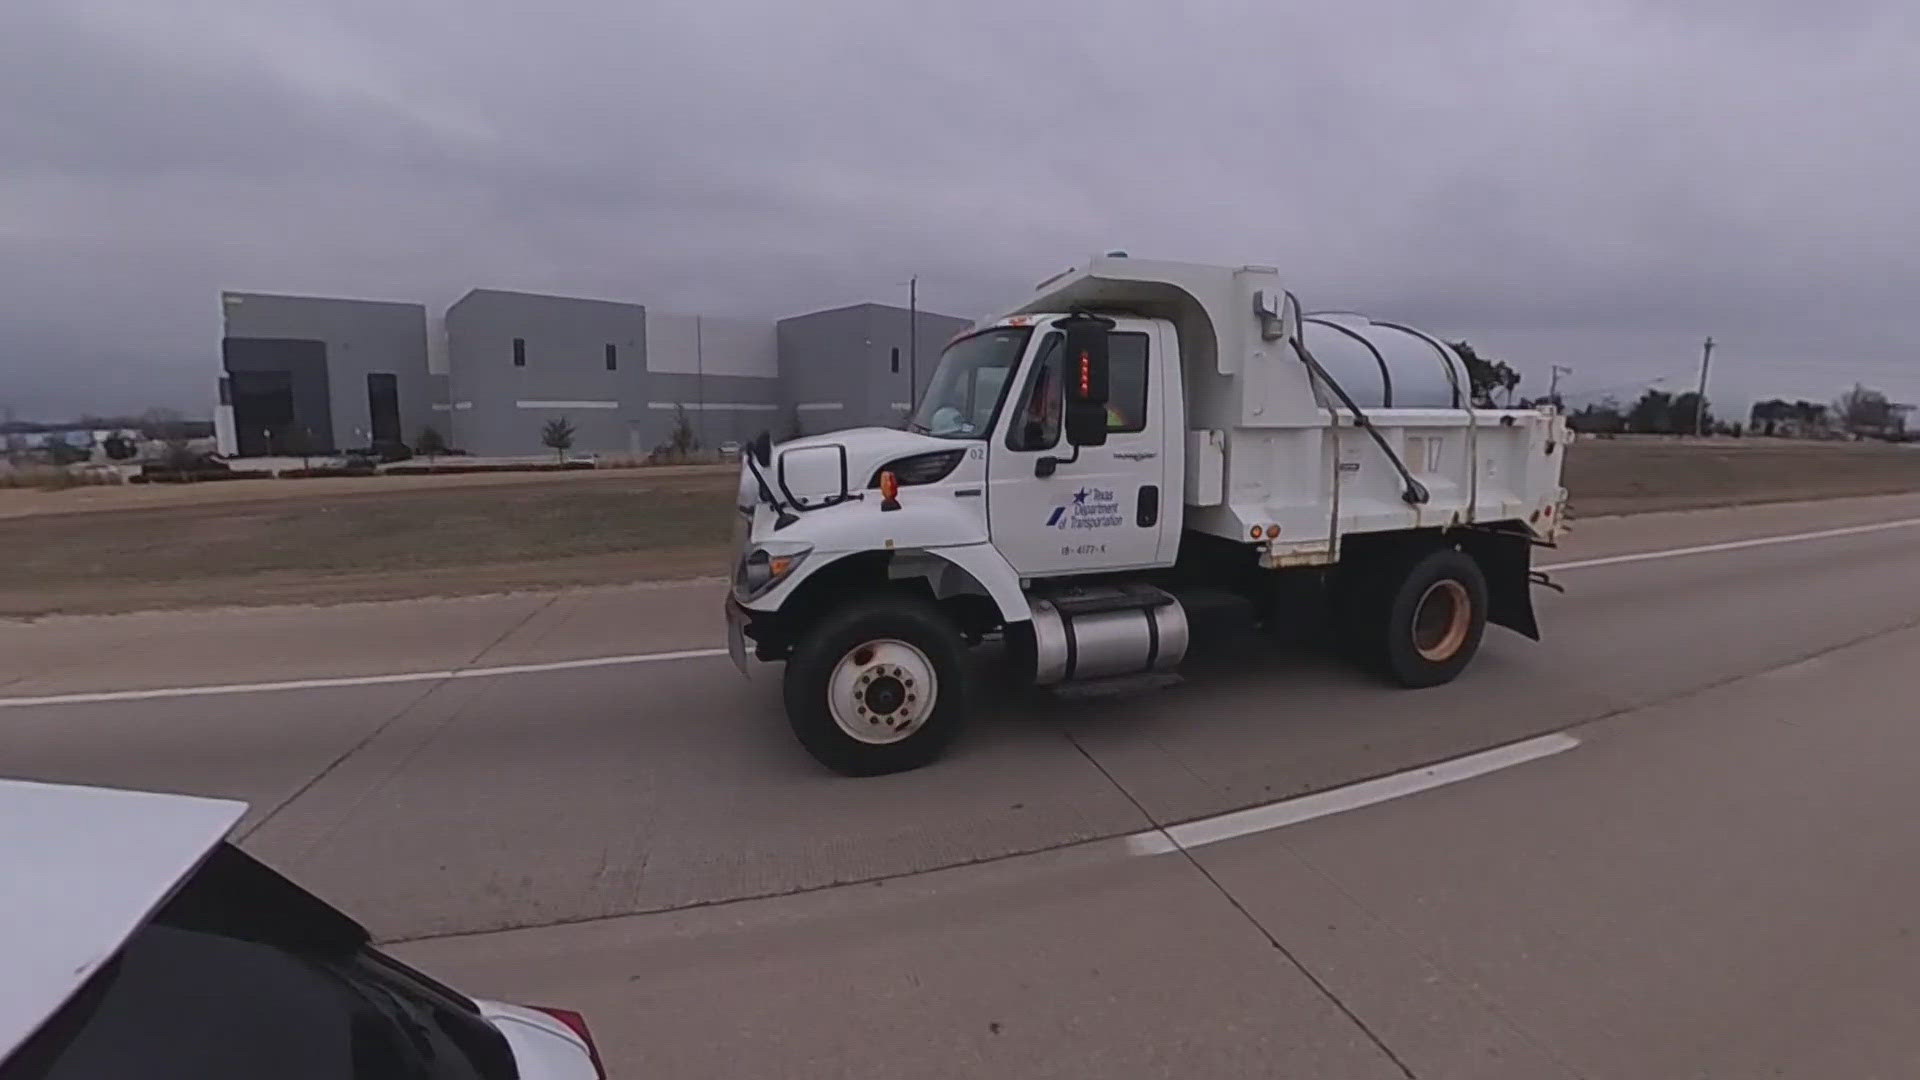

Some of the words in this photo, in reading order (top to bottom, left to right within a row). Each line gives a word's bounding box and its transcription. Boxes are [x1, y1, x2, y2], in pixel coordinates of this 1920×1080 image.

[970, 448, 984, 460] 02
[1093, 488, 1114, 501] Texas
[1074, 503, 1119, 516] Department
[1057, 517, 1067, 530] of
[1071, 516, 1123, 530] Transportation
